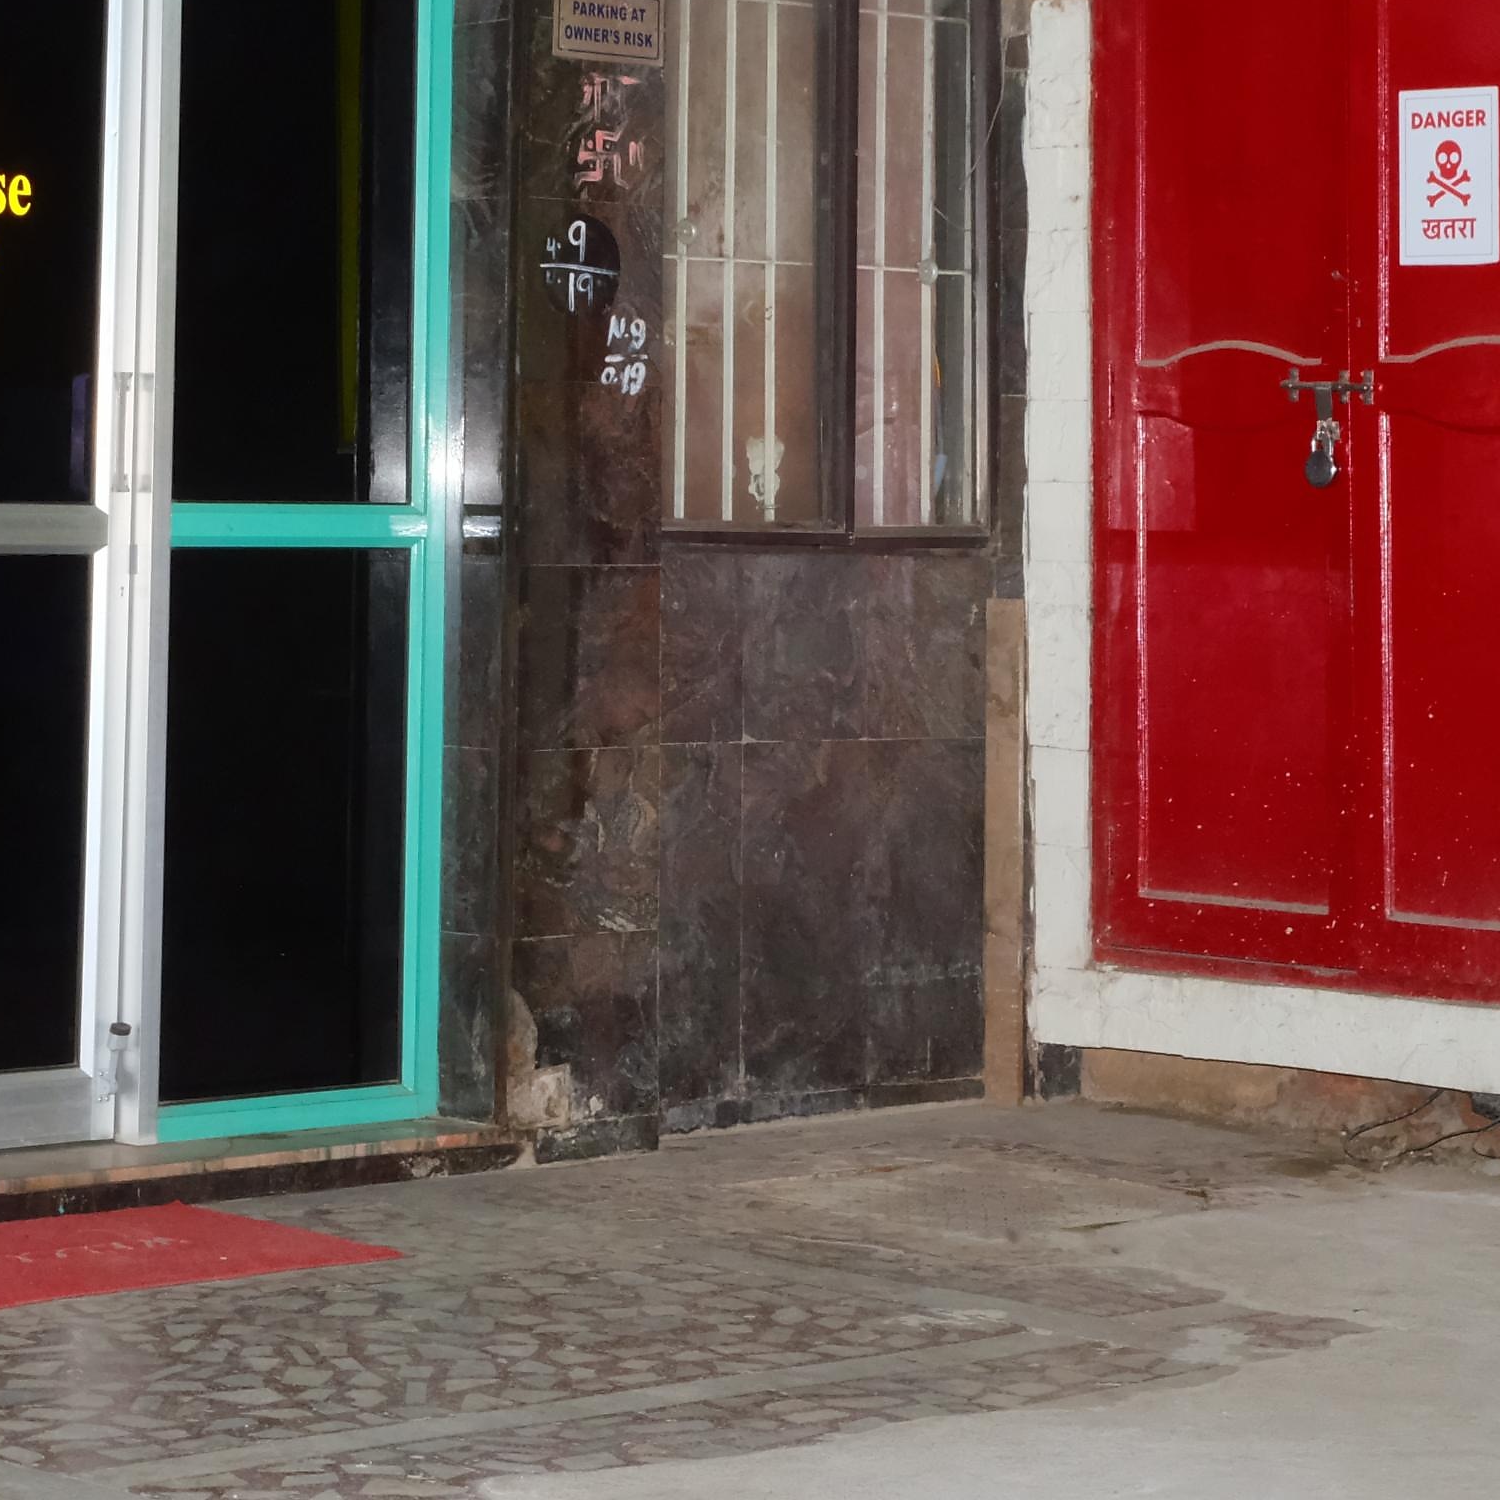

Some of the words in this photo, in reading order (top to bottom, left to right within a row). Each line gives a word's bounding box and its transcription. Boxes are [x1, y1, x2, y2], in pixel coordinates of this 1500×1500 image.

[631, 8, 647, 23] AT
[564, 24, 621, 45] OWNER'S
[624, 31, 653, 48] RISK
[1411, 109, 1487, 130] DANGER
[1421, 217, 1477, 240] खतरा
[568, 219, 587, 263] 9
[568, 271, 594, 314] 19
